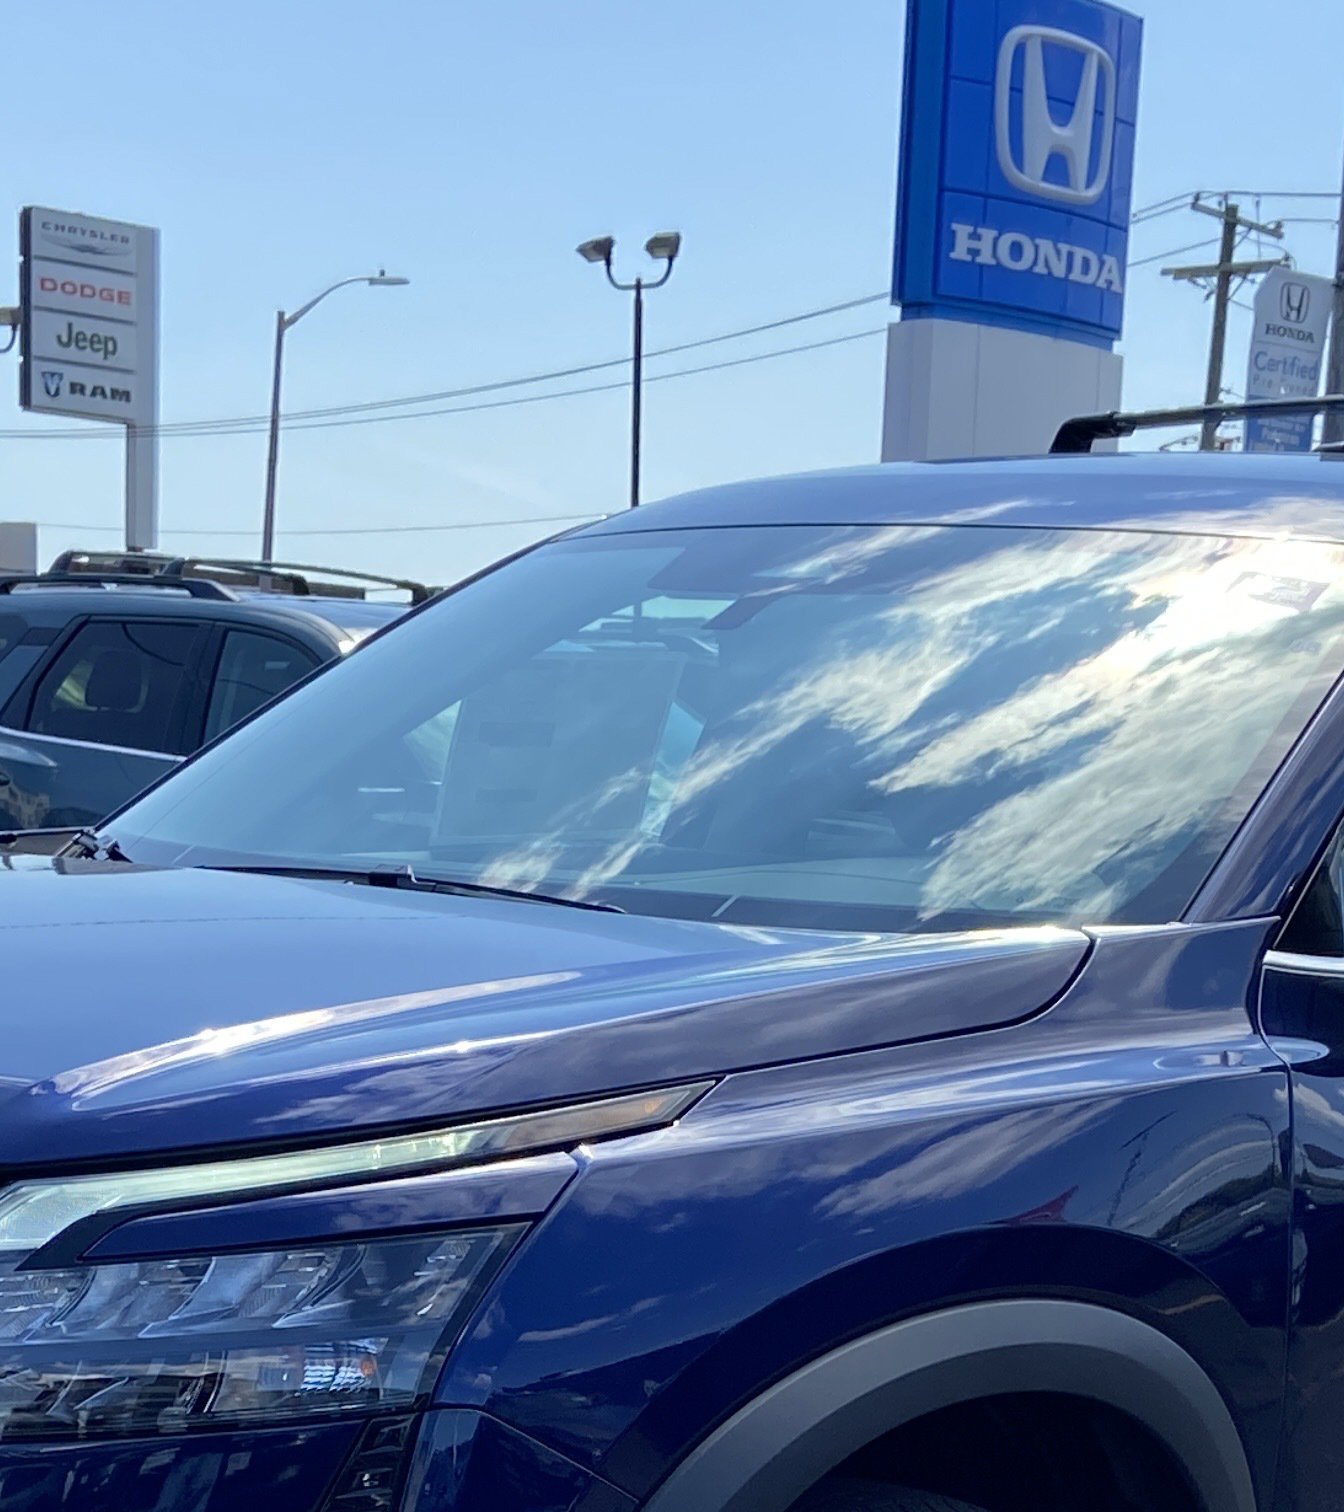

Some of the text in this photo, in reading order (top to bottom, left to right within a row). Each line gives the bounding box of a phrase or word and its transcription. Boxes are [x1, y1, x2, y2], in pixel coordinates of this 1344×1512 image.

[41, 220, 130, 244] CHRYSLER
[949, 222, 1123, 294] HONDA
[39, 277, 132, 305] DODGE
[56, 321, 118, 360] Jeep
[1265, 322, 1315, 343] HONDA
[1253, 351, 1319, 381] Certified
[69, 381, 131, 403] RAM
